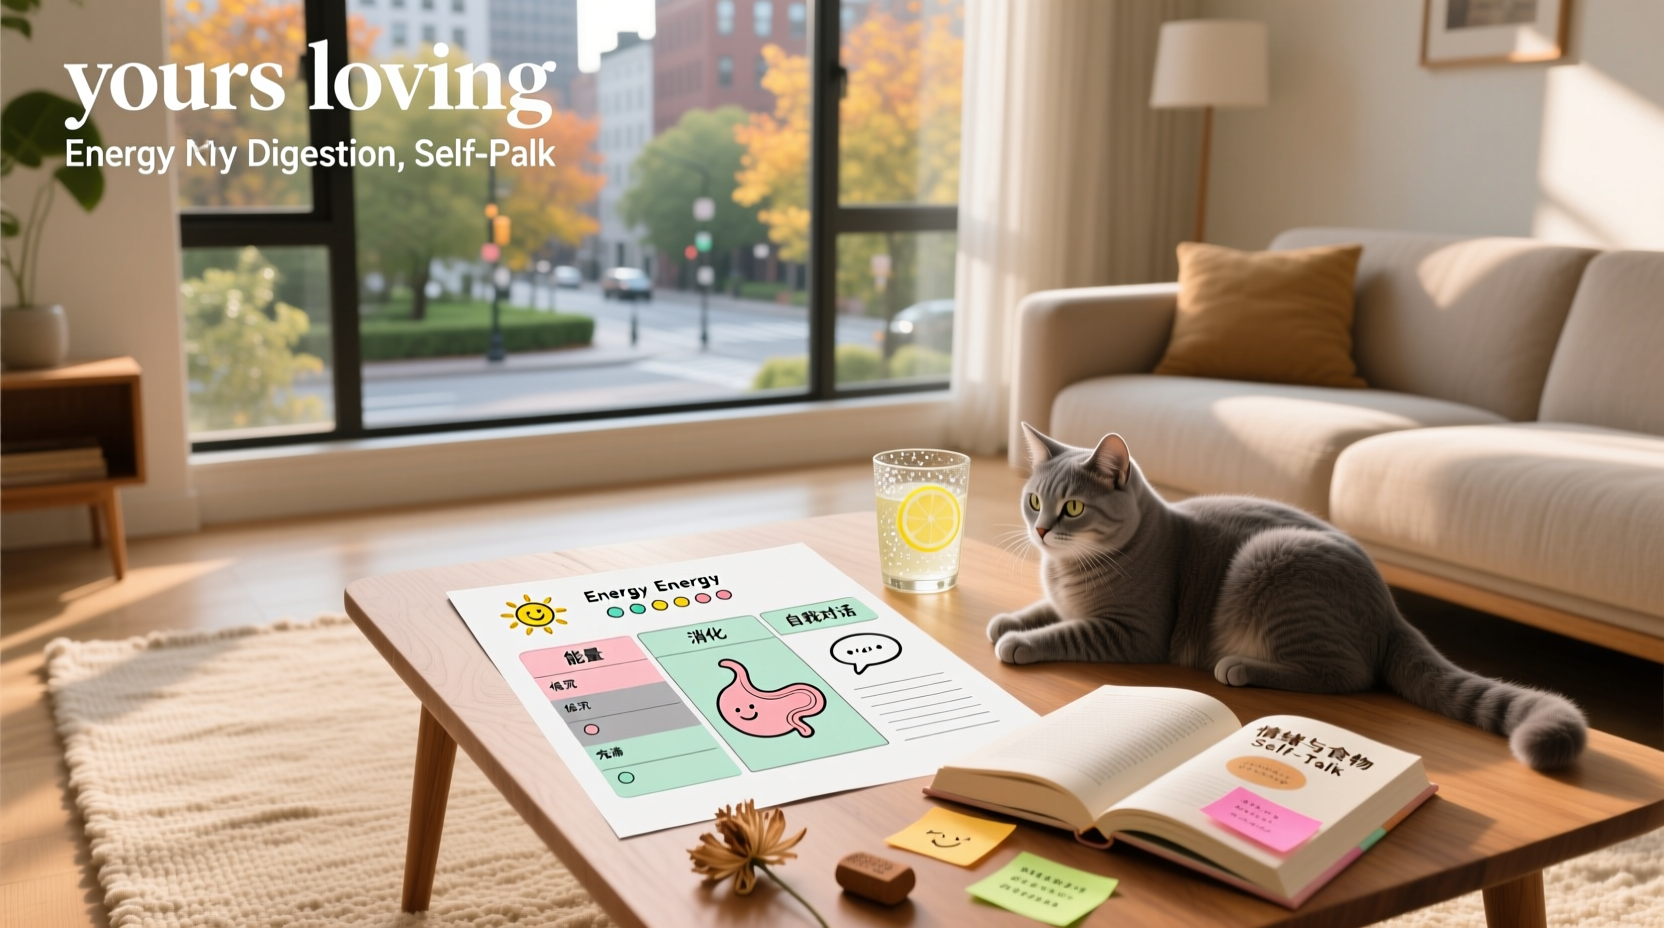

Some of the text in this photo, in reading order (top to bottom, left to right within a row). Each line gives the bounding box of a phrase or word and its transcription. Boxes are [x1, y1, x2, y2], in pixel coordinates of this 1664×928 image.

[583, 575, 719, 603] Energy Energy
[785, 604, 857, 627] 自我对话
[686, 627, 728, 644] 消化
[563, 647, 605, 666] 能量
[1250, 738, 1345, 777] Self-Talk
[1256, 724, 1375, 772] 情绪与食物
